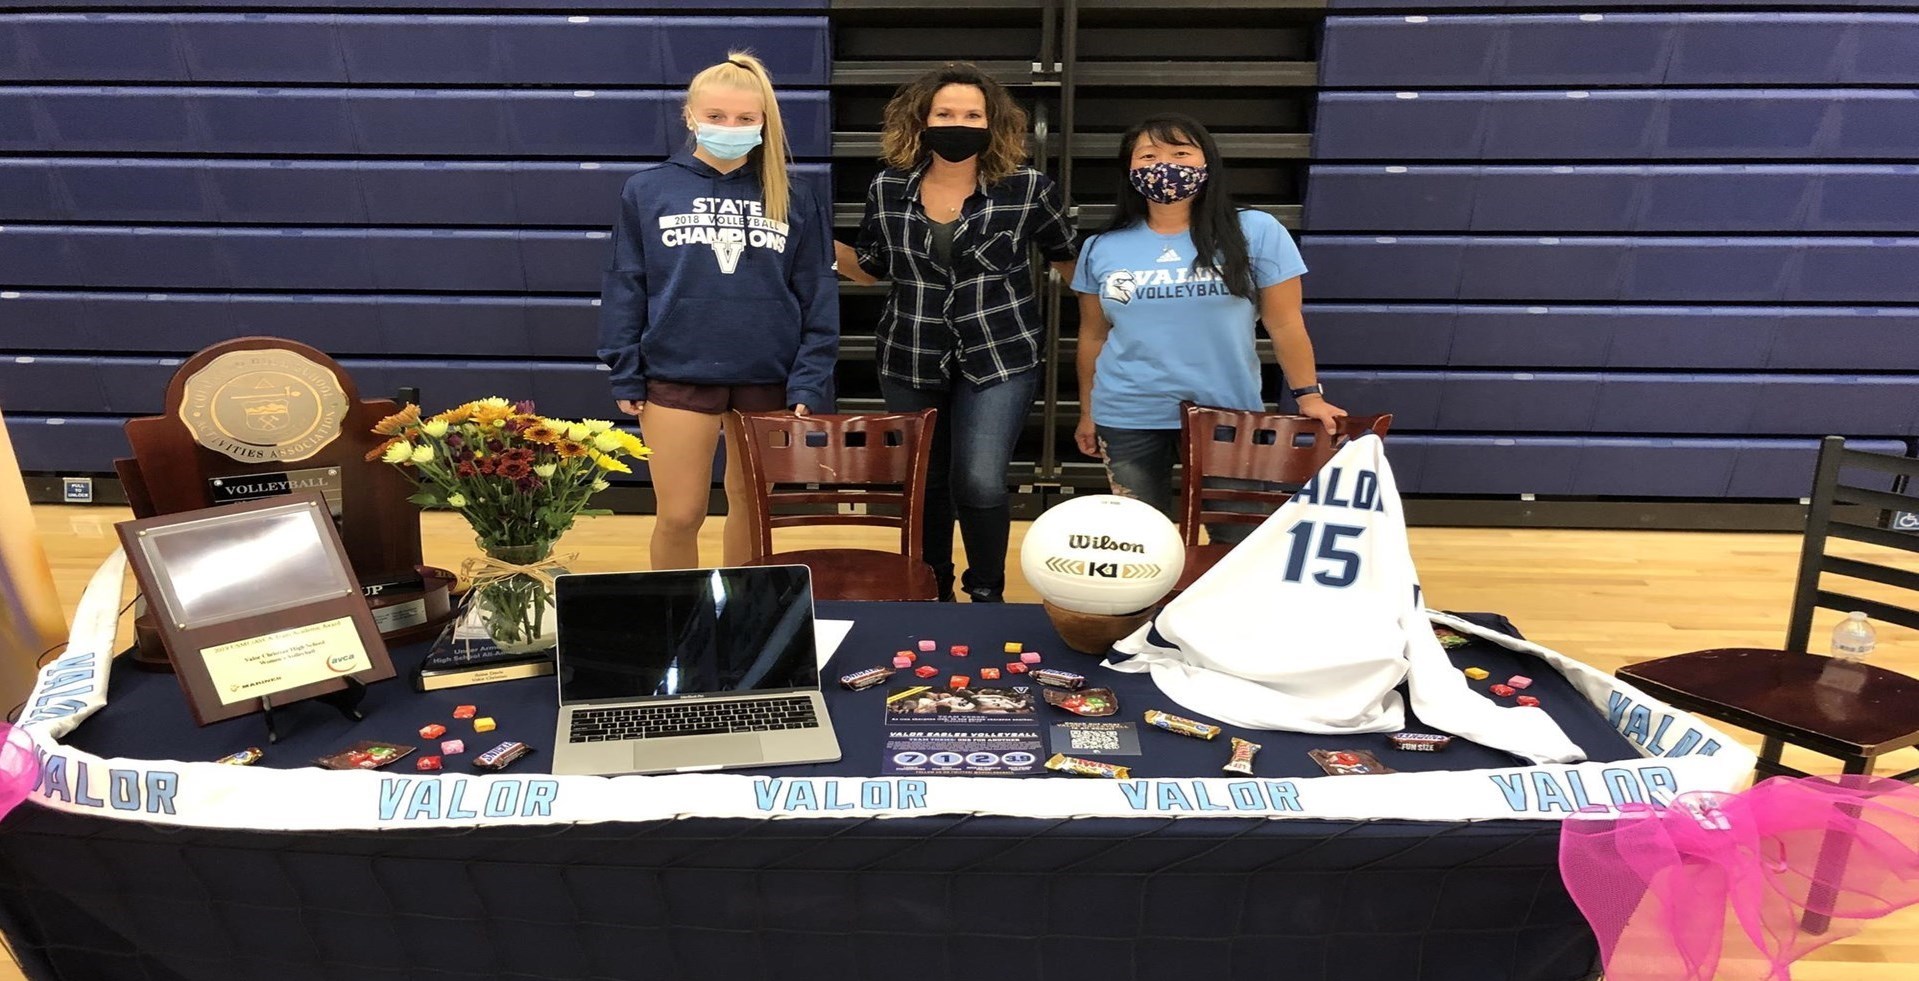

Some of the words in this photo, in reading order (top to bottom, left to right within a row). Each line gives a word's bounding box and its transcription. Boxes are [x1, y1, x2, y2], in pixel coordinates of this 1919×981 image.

[692, 197, 762, 216] STATE
[674, 215, 700, 225] 2018
[708, 215, 779, 231] VOLLEYBALL
[661, 227, 786, 254] CHAMPIONS
[711, 242, 744, 274] V
[1132, 265, 1224, 287] VALO
[1135, 284, 1230, 300] VOLLEYBAL
[270, 410, 336, 458] ASSOCIATION
[225, 477, 328, 496] VOLLEYBALL
[1289, 466, 1385, 513] ALO
[1069, 534, 1145, 554] Wilson
[1282, 519, 1367, 589] 15
[1088, 561, 1118, 579] K1
[331, 652, 355, 665] avca
[1418, 743, 1434, 751] SIZE
[903, 754, 919, 763] 7
[940, 754, 950, 763] 1
[975, 754, 991, 763] 2
[378, 777, 560, 820] VALOR
[753, 779, 928, 811] VALOR
[1120, 780, 1304, 812] VALOR
[1488, 766, 1679, 813] VALOR
